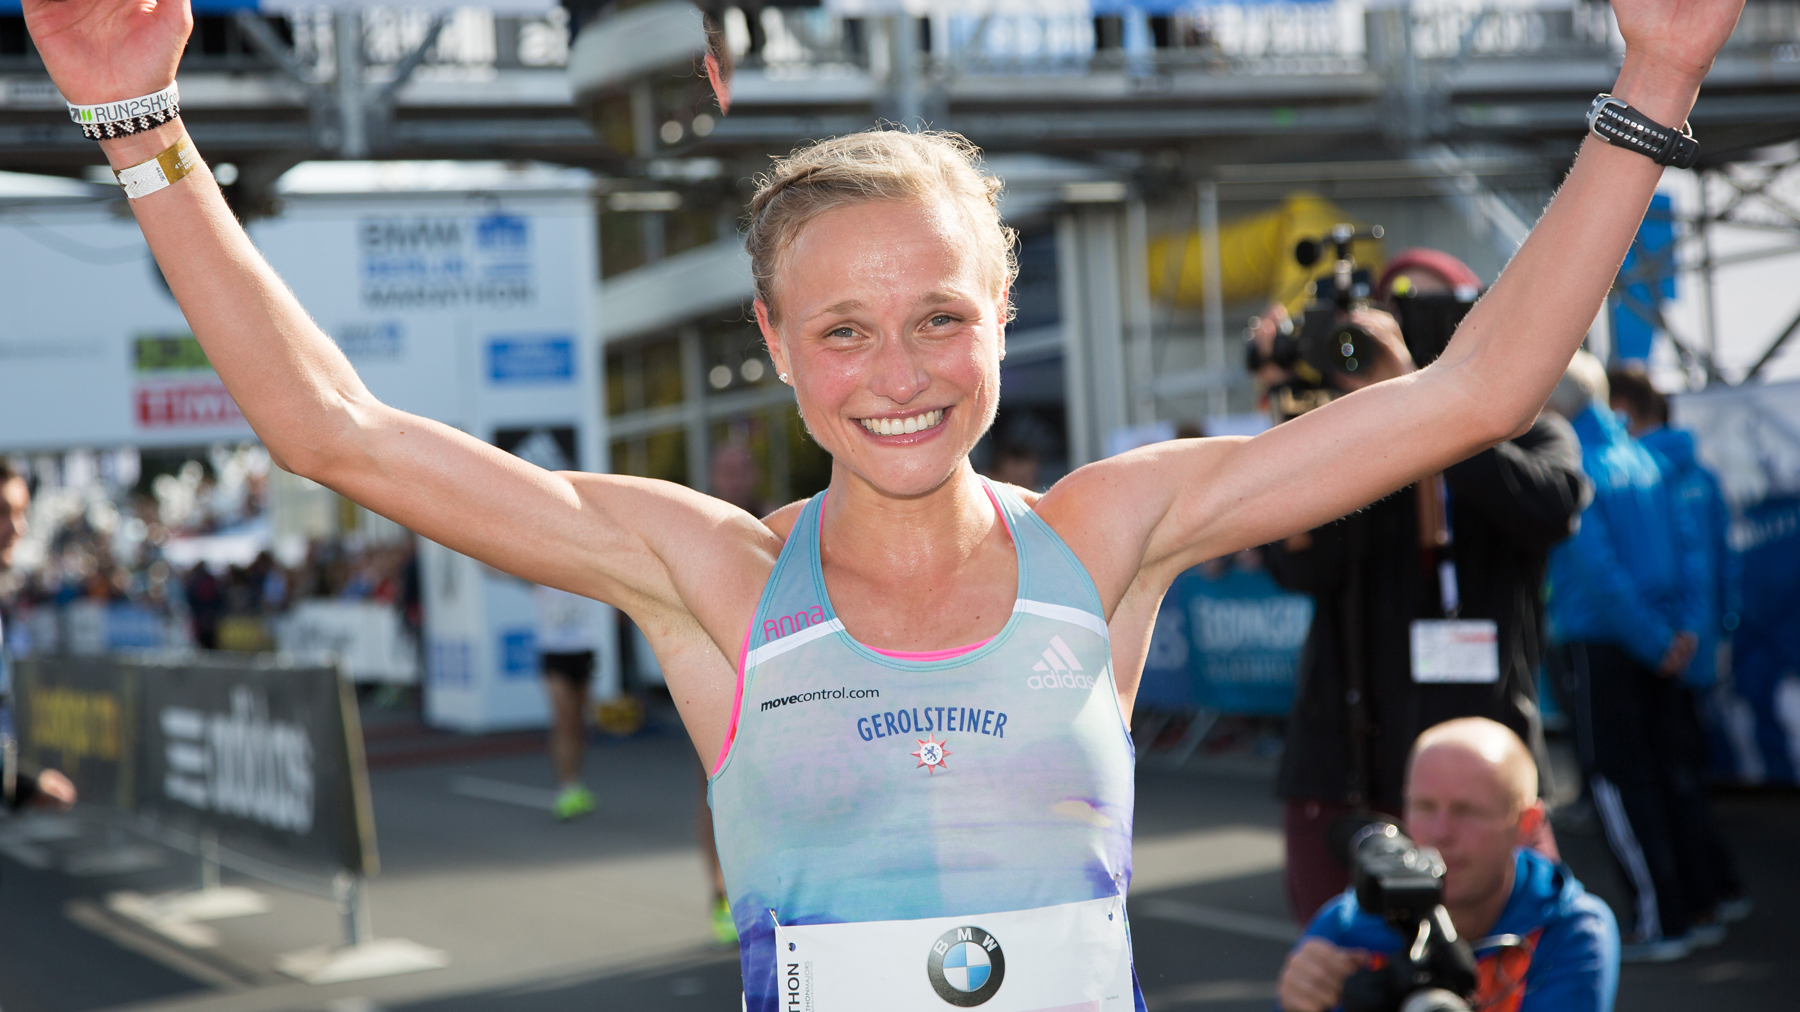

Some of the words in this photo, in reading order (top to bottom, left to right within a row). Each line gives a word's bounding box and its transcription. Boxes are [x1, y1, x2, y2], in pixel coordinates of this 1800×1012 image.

[763, 605, 825, 642] Anna
[1026, 669, 1096, 690] adidas
[760, 686, 880, 712] movecontrol.com
[857, 706, 1008, 742] GEROLSTEINER
[933, 927, 999, 957] BMW
